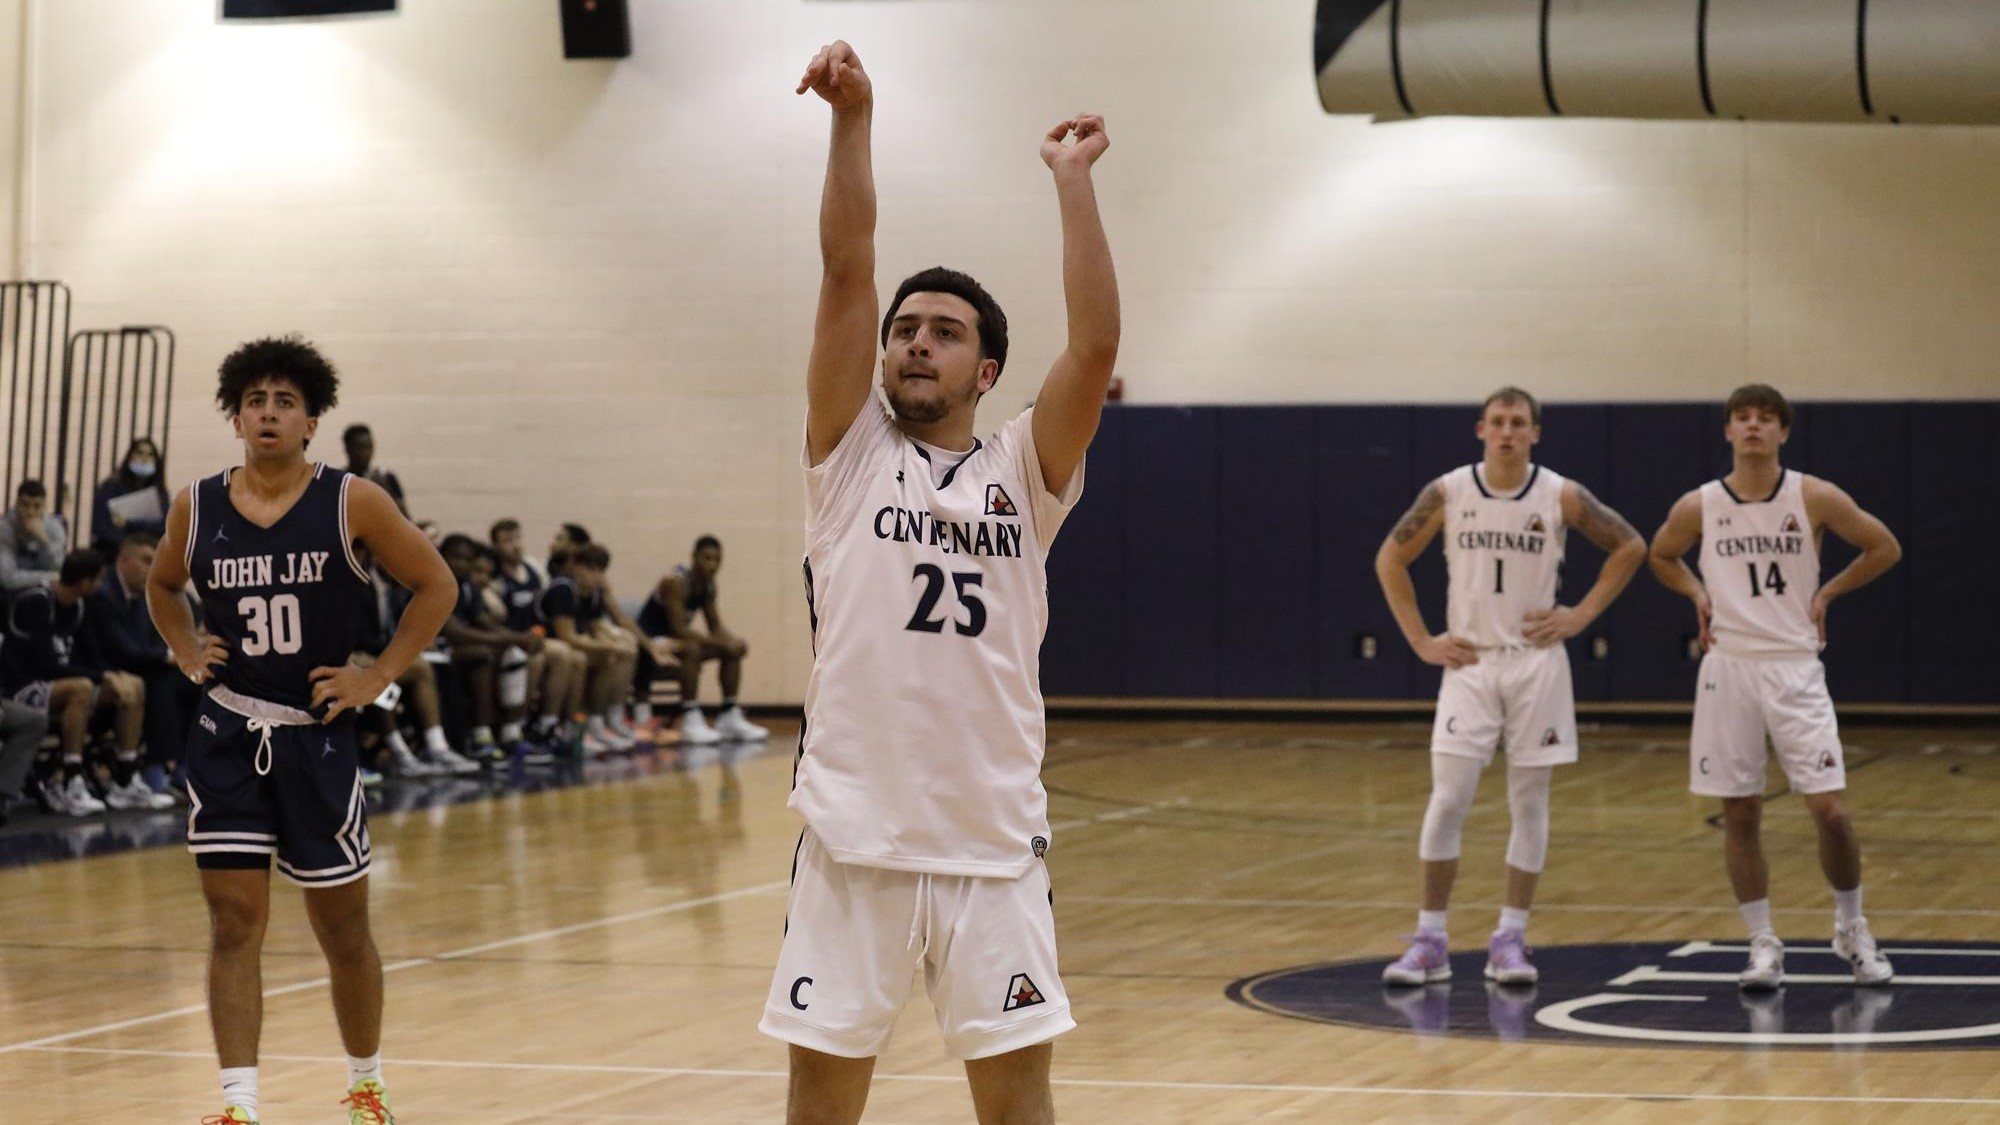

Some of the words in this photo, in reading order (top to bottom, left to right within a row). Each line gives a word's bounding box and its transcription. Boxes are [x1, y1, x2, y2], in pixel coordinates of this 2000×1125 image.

[874, 505, 1022, 558] CENTENARY
[1458, 531, 1546, 555] CENTENARY
[1716, 535, 1803, 556] CENTENARY
[207, 555, 273, 590] JOHN
[280, 551, 329, 585] JAY
[1494, 558, 1504, 594] 1
[1747, 562, 1787, 597] 14
[904, 563, 987, 637] 25
[237, 593, 303, 656] 30
[790, 976, 813, 1011] C
